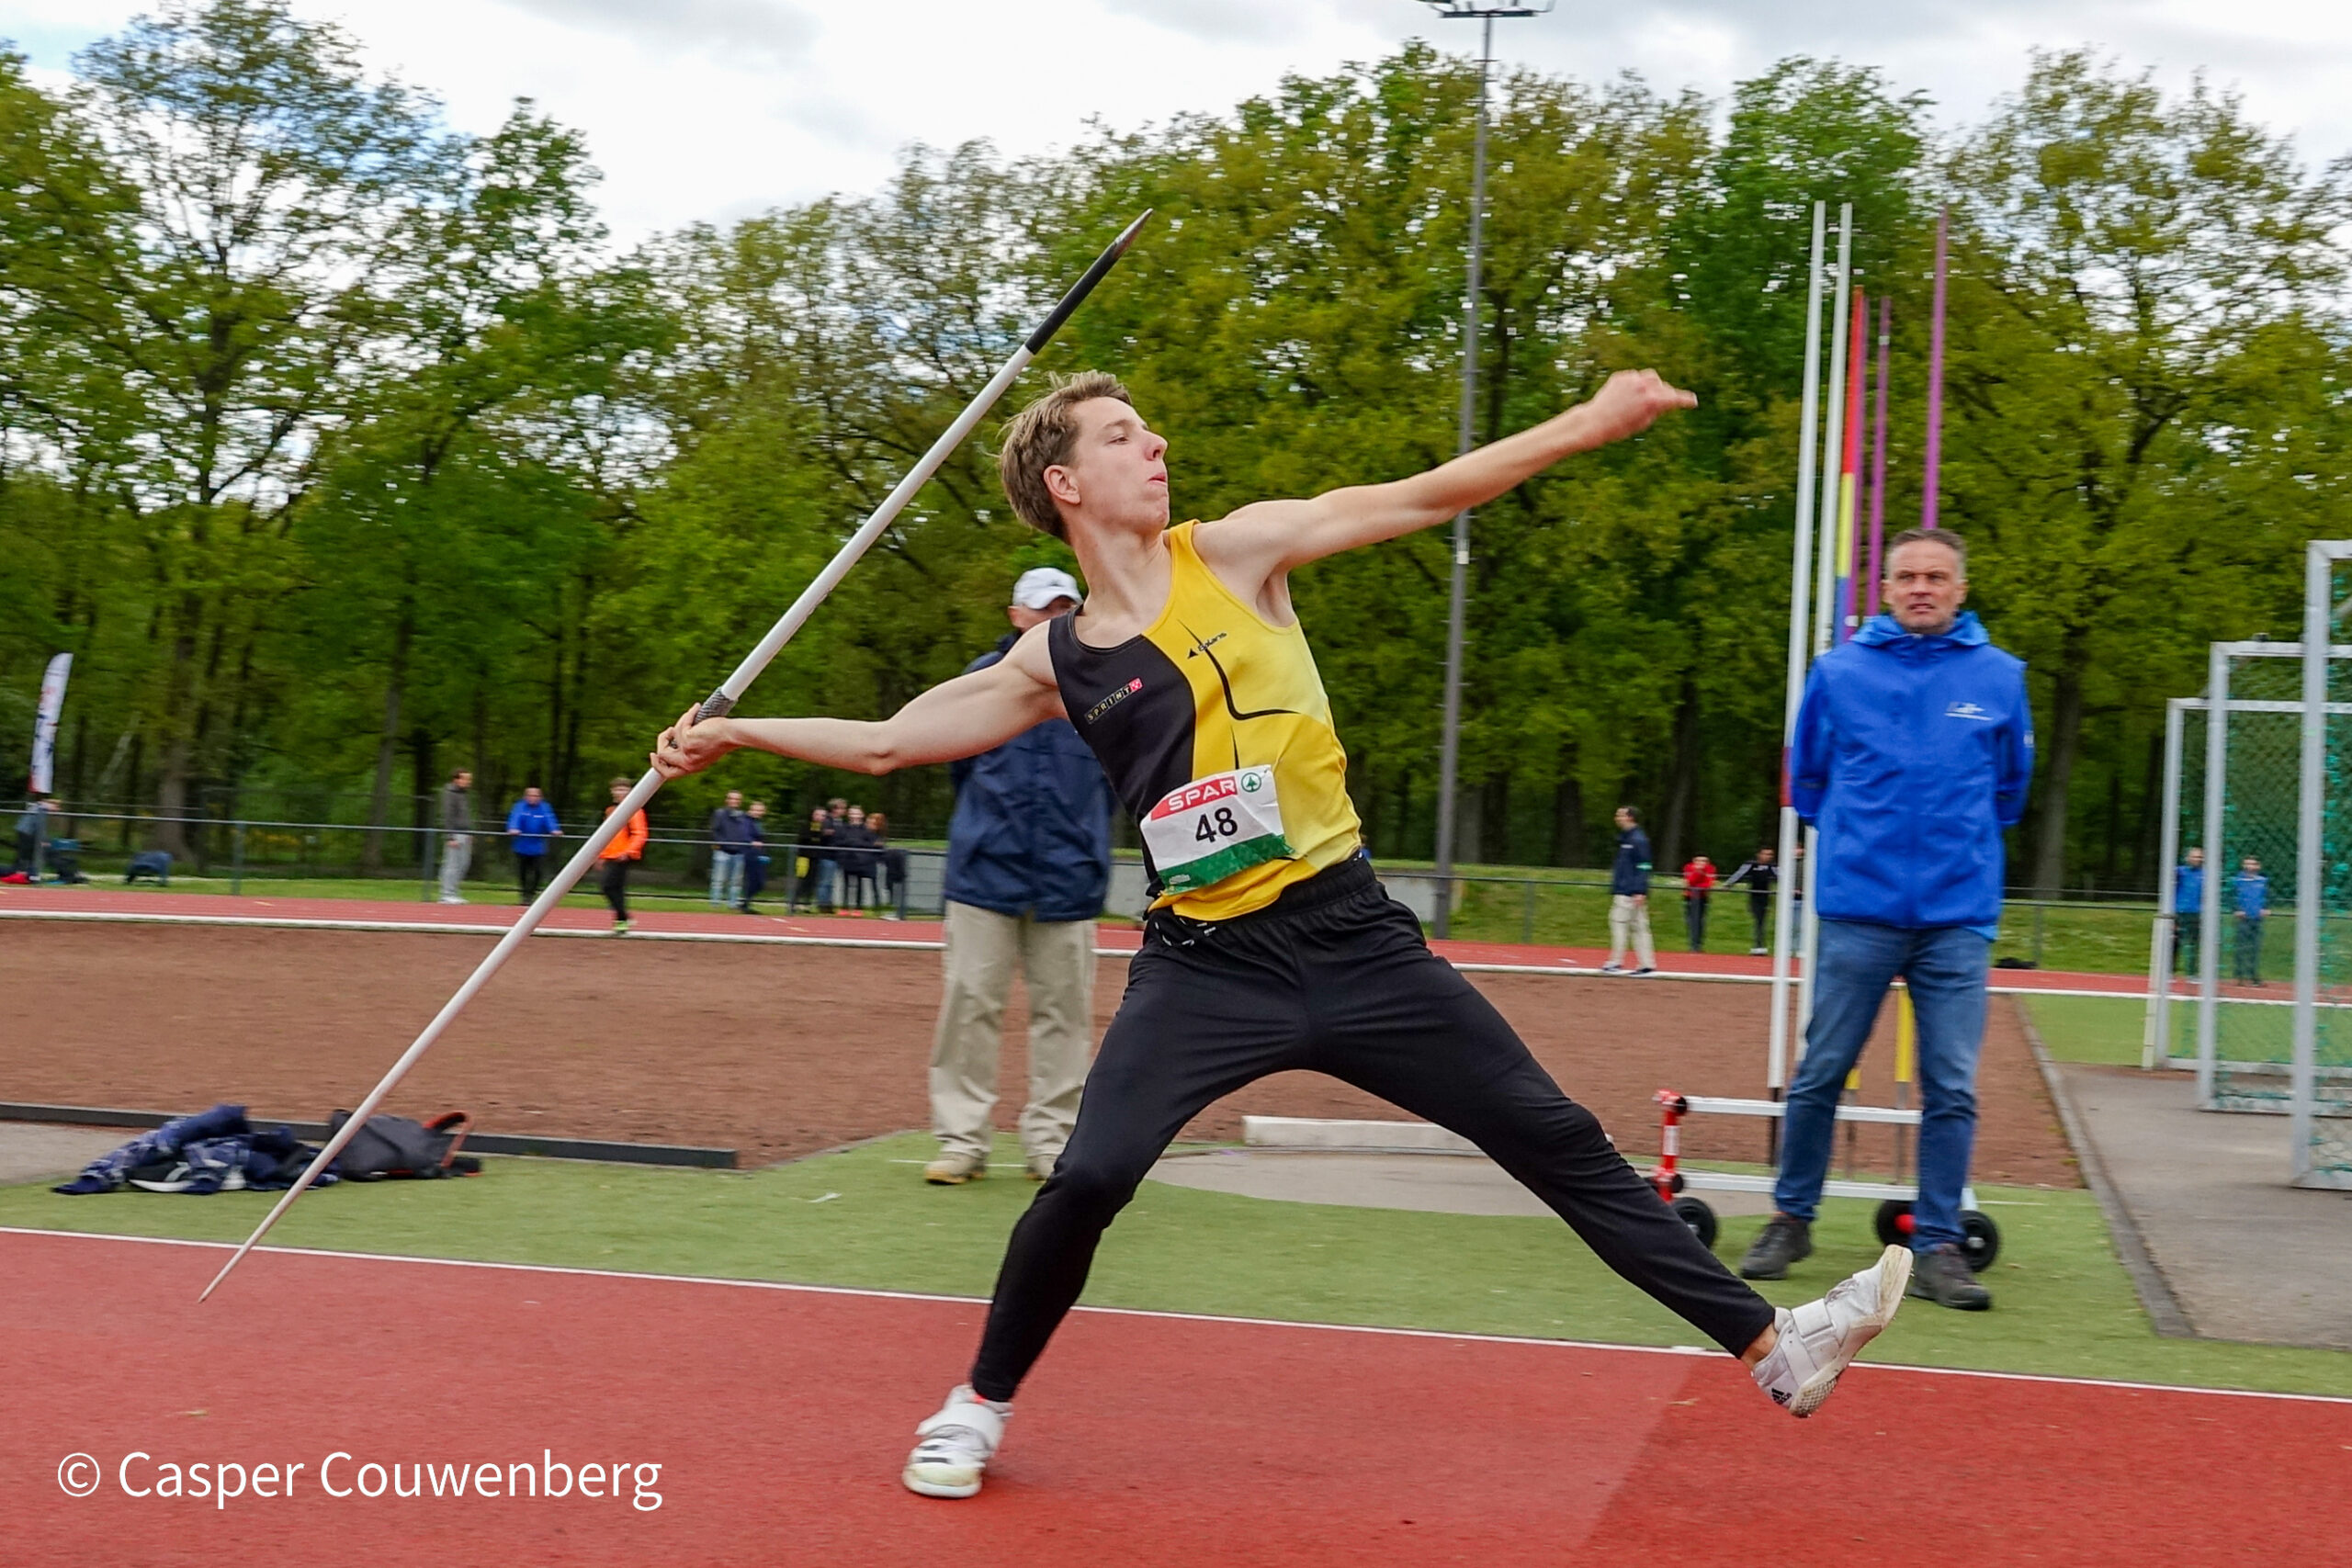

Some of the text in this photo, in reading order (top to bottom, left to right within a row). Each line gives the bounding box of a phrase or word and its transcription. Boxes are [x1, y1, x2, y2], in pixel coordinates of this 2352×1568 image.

[1087, 685, 1131, 721] SPRINT
[1168, 780, 1236, 811] SPAR
[1195, 807, 1238, 842] 48
